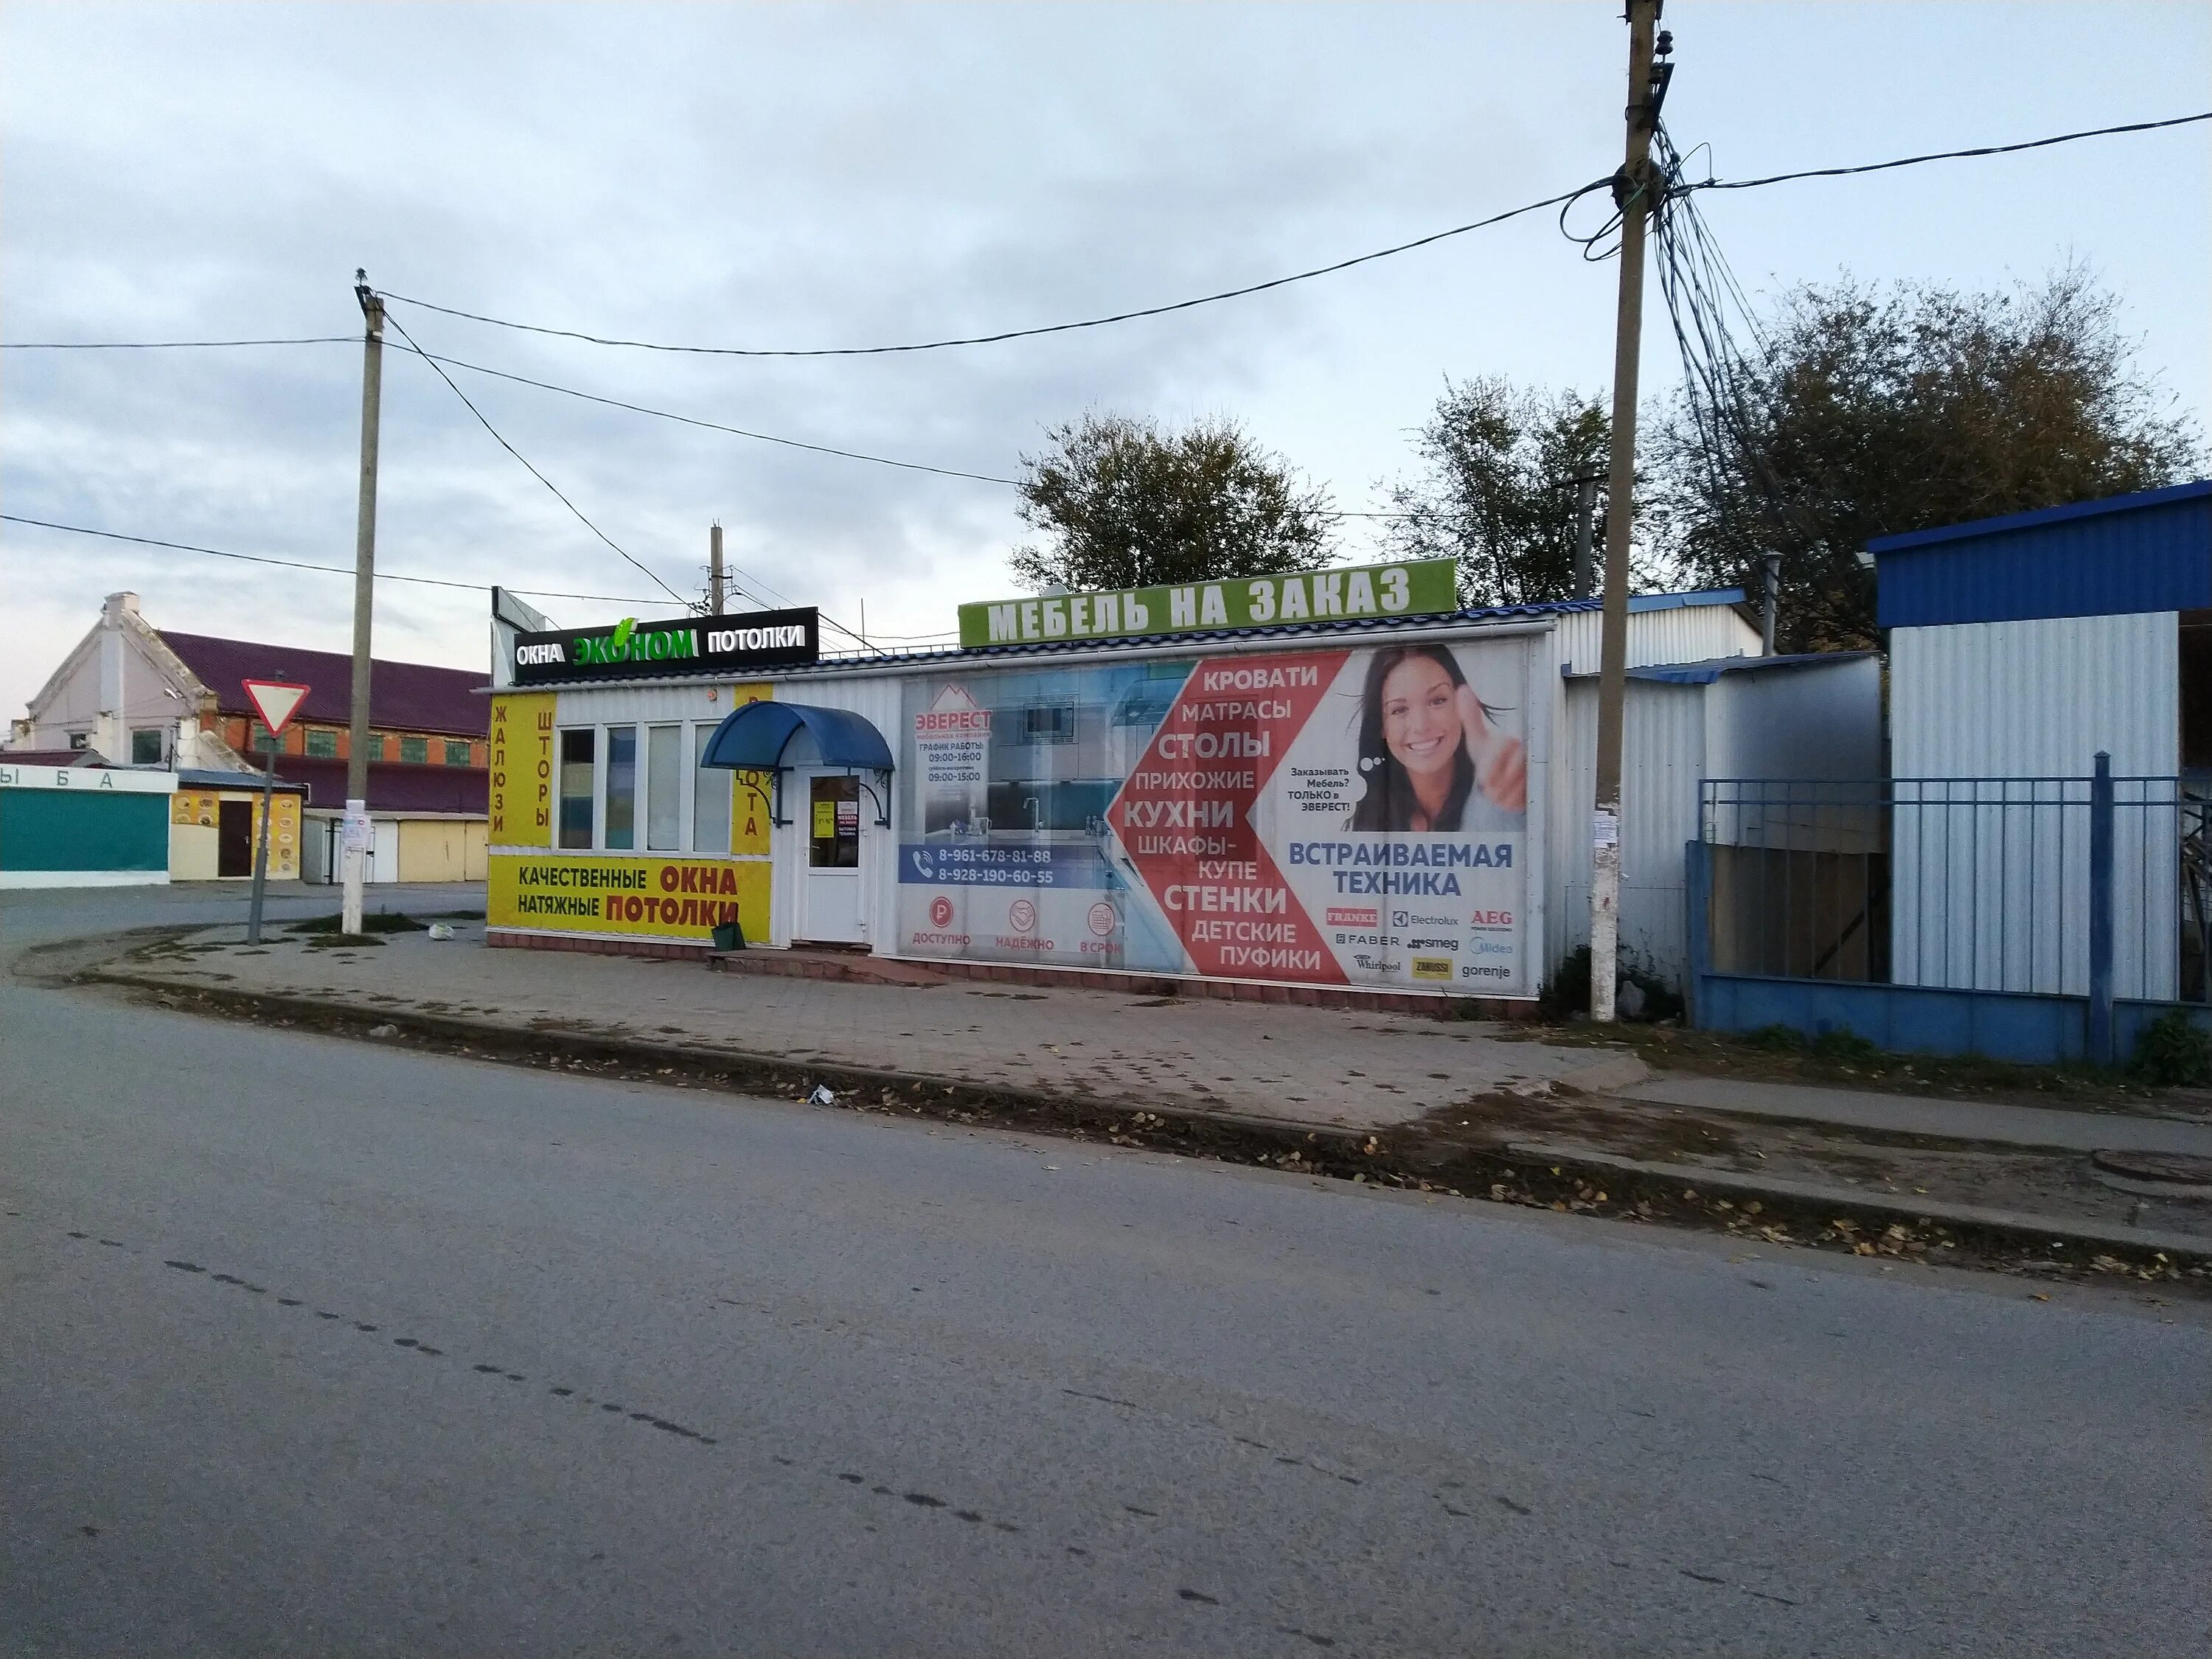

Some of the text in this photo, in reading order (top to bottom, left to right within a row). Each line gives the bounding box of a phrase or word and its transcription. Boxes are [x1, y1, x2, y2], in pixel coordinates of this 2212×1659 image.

[987, 567, 1411, 641] МЕБЕЛЬ НА ЗАКАЗ
[516, 625, 805, 666] ОКНА ЭКОНОМ ПОТОЛКИ
[1203, 666, 1318, 691] КРОВАТИ
[1182, 700, 1291, 722] МАТРАСЫ
[915, 711, 992, 731] ЭВЕРЕСТ
[919, 742, 949, 751] ГРАФИК
[1158, 731, 1270, 759] СТОЛЫ
[494, 706, 507, 832] ЖАЛЮЗИ
[536, 712, 552, 827] ШТОРЫ
[929, 771, 981, 782] 09:00-15:00
[1290, 768, 1349, 776] Заказывать
[1135, 771, 1254, 790] ПРИХОЖИЕ
[1307, 779, 1349, 787] Мебель?
[1288, 790, 1332, 800] ТОЛЬКО
[1124, 801, 1234, 827] КУХНИ
[1301, 802, 1350, 812] ЭВЕРЕСТ!
[1138, 835, 1237, 855] ШКАФЫ-
[939, 849, 1051, 863] 8-961-678-81-88
[1290, 842, 1513, 868] ВСТРАИВАЕМАЯ
[938, 868, 1054, 884] 8-928-190-60-55
[1198, 860, 1257, 880] КУПЕ
[518, 866, 738, 896] КАЧЕСТВЕННЫЕ ОКНА
[1332, 871, 1462, 897] ТЕХНИКА
[1164, 885, 1286, 914] СТЕНКИ
[518, 894, 739, 927] НАТЯЖНЫЕ ПОТОЛКИ
[1327, 912, 1377, 922] FRANKE
[1471, 910, 1513, 925] AEG
[1411, 915, 1459, 926] Electrolux
[913, 933, 971, 945] ДОСТУПНО
[1192, 920, 1296, 943] ДЕТСКИЕ
[1349, 935, 1400, 946] FABER
[996, 936, 1054, 950] НАДЁЖНО
[1080, 942, 1121, 954] В СРОК
[1425, 939, 1459, 951] smeg
[1220, 946, 1321, 970] ПУФИКИ
[1357, 959, 1401, 973] Whirlpool
[1462, 967, 1511, 979] gorenje
